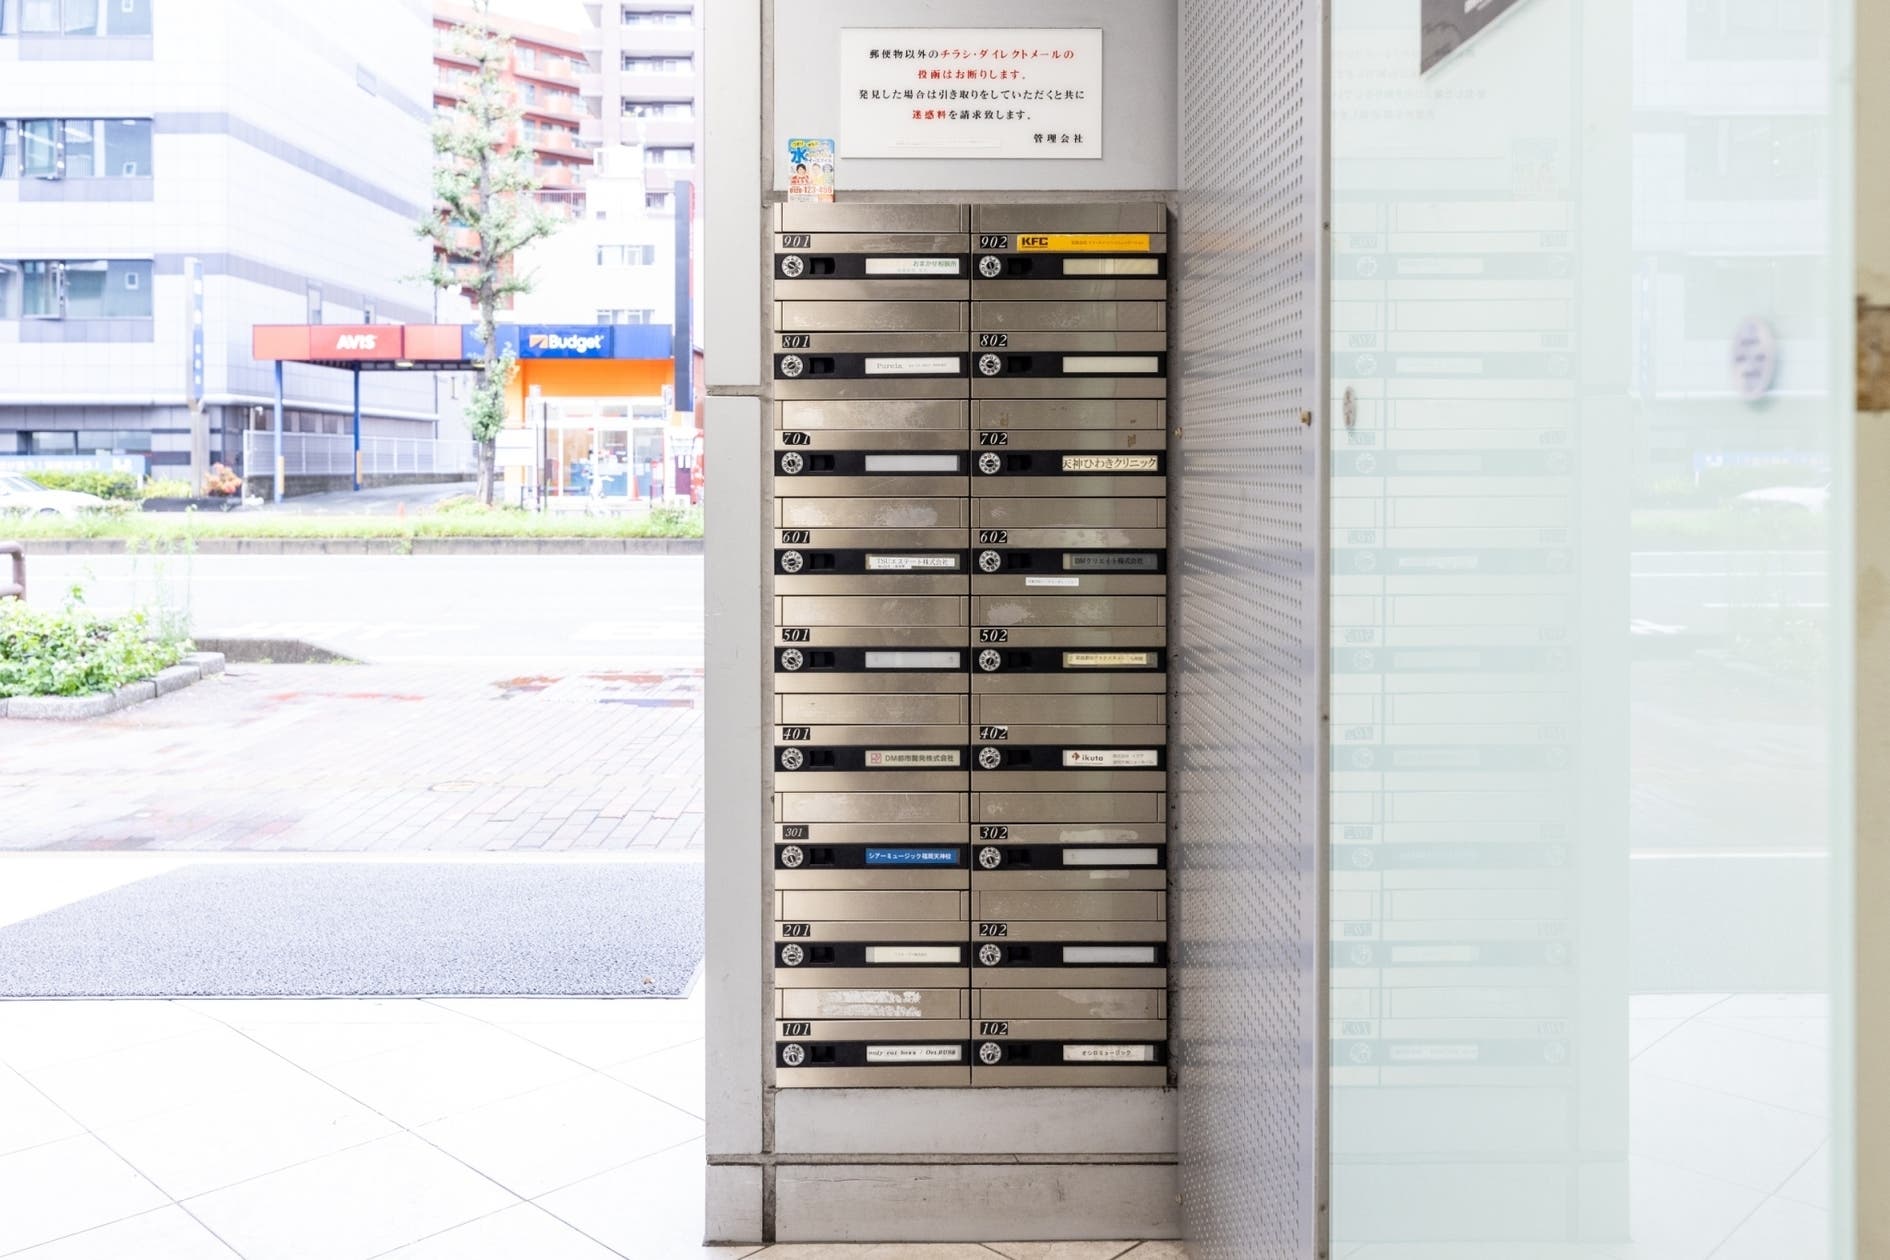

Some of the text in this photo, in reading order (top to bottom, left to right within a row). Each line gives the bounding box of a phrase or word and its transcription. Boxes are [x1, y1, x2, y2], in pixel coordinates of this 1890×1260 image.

[869, 48, 1075, 61] 郵便物以外のチラシ・ダイレクトメールの
[917, 68, 1027, 80] 投函はお断りします。
[858, 89, 1085, 101] 発見した場合は引き取りをしていただくと共に
[911, 109, 1032, 121] 迷惑料を請求致します。
[1033, 132, 1084, 144] 管理会社
[783, 235, 810, 248] 901
[980, 235, 1007, 248] 902
[1021, 237, 1048, 246] KFC
[336, 334, 376, 350] AVIS
[548, 334, 602, 353] Budget
[783, 334, 810, 347] 801
[980, 334, 1007, 347] 802
[783, 432, 810, 445] 701
[980, 432, 1007, 445] 702
[1062, 456, 1157, 470] 天神ひわきクリニック
[783, 530, 810, 543] 601
[980, 530, 1007, 543] 602
[783, 629, 810, 642] 501
[980, 629, 1007, 642] 502
[783, 727, 810, 740] 401
[980, 727, 1007, 740] 402
[785, 826, 804, 838] 301
[980, 826, 1007, 839] 302
[783, 924, 810, 937] 201
[980, 924, 1007, 937] 202
[783, 1022, 810, 1035] 101
[980, 1022, 1007, 1035] 102
